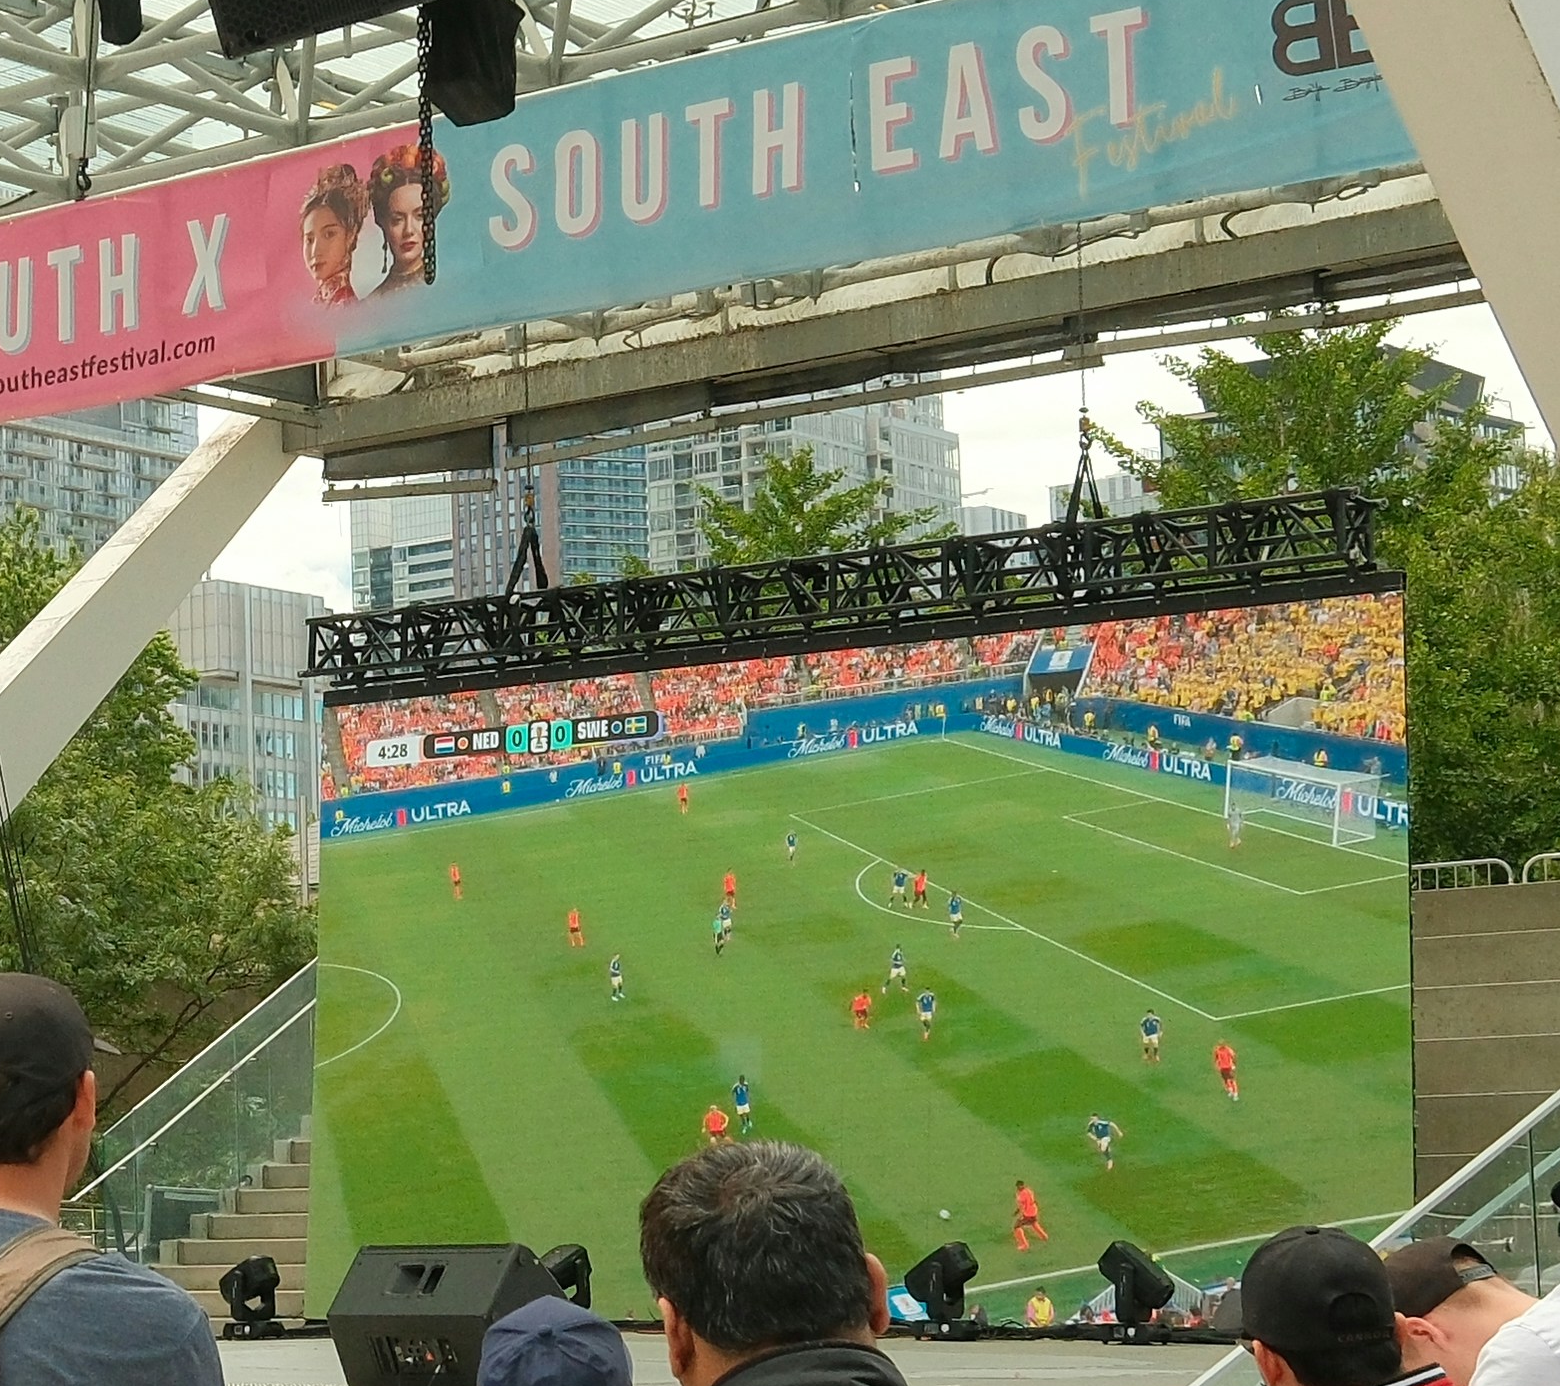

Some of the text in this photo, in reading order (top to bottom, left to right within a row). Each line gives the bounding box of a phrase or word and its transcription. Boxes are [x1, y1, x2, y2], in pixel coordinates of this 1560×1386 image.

[489, 6, 1149, 253] SOUTH EAST
[181, 213, 230, 317] X
[472, 719, 609, 750] NED 0 0 SWE
[861, 720, 919, 744] ULTRA
[1024, 724, 1062, 749] ULTRA
[378, 743, 408, 759] 4:28
[639, 761, 699, 783] ULTRA
[1162, 753, 1212, 781] ULTRA
[330, 799, 471, 838] Michelob ULTRA
